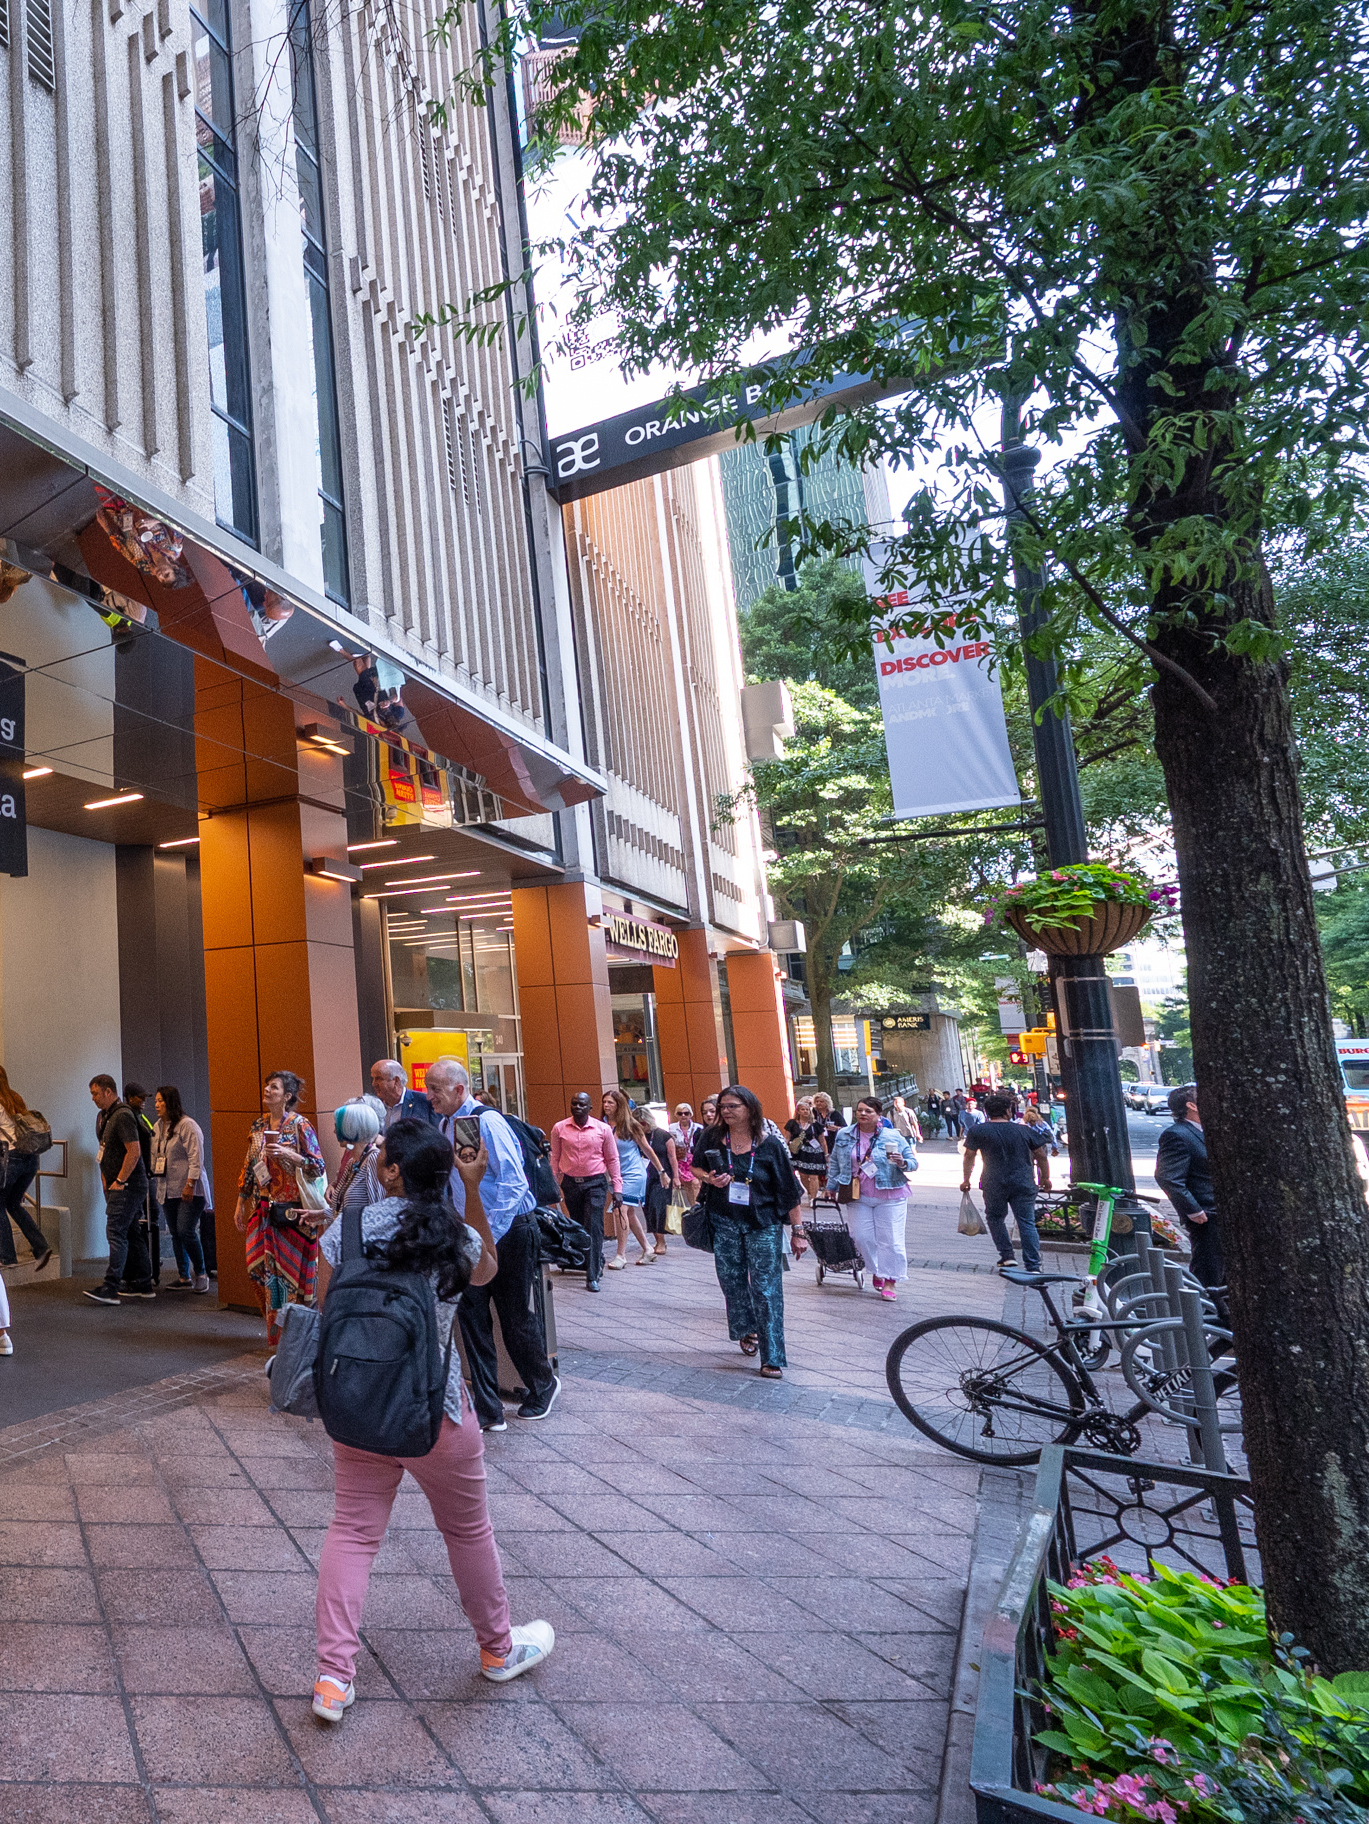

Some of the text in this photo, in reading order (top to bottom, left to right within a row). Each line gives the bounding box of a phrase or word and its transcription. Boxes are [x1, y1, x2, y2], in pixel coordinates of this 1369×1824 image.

[880, 641, 991, 677] DISCOVER
[606, 912, 679, 959] WELLS FARGO
